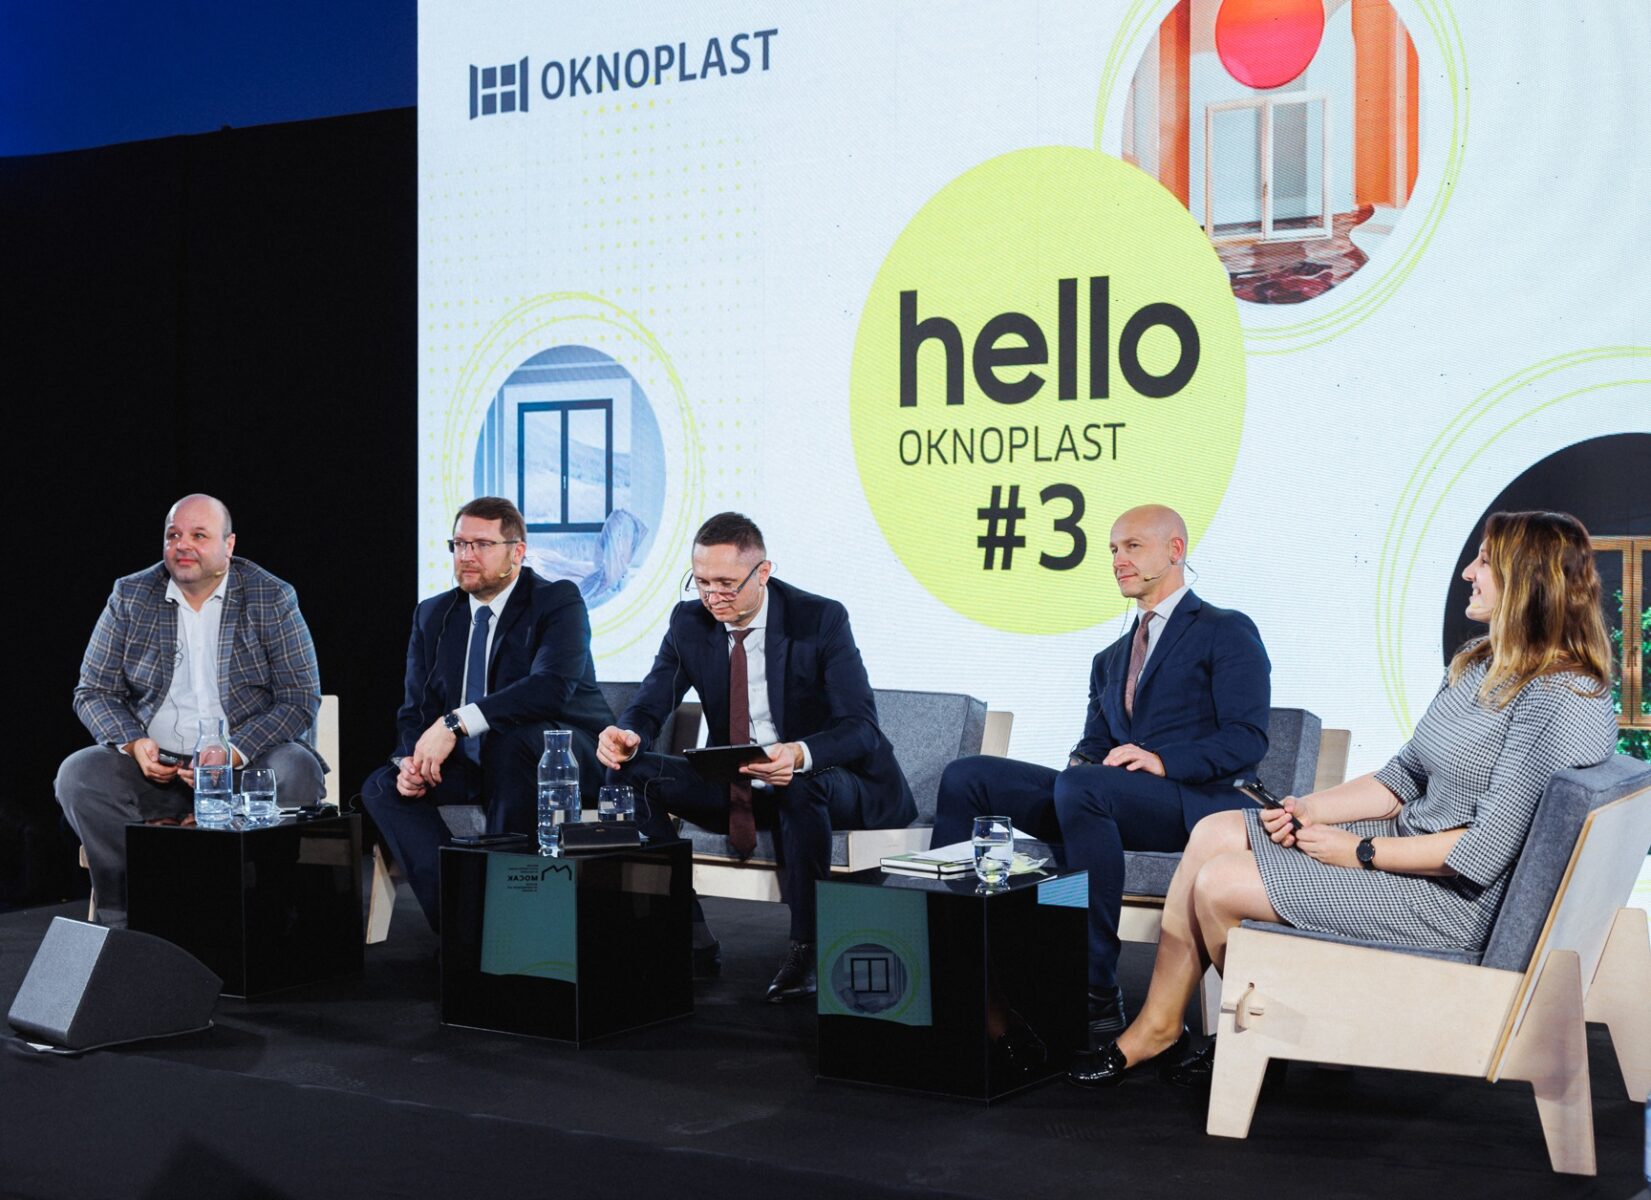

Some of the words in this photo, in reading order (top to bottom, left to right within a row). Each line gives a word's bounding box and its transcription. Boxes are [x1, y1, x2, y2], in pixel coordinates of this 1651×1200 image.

[542, 29, 778, 100] OKNOPLAST
[900, 275, 1200, 407] hello
[899, 423, 1126, 465] OKNOPLAST
[977, 483, 1087, 571] #3
